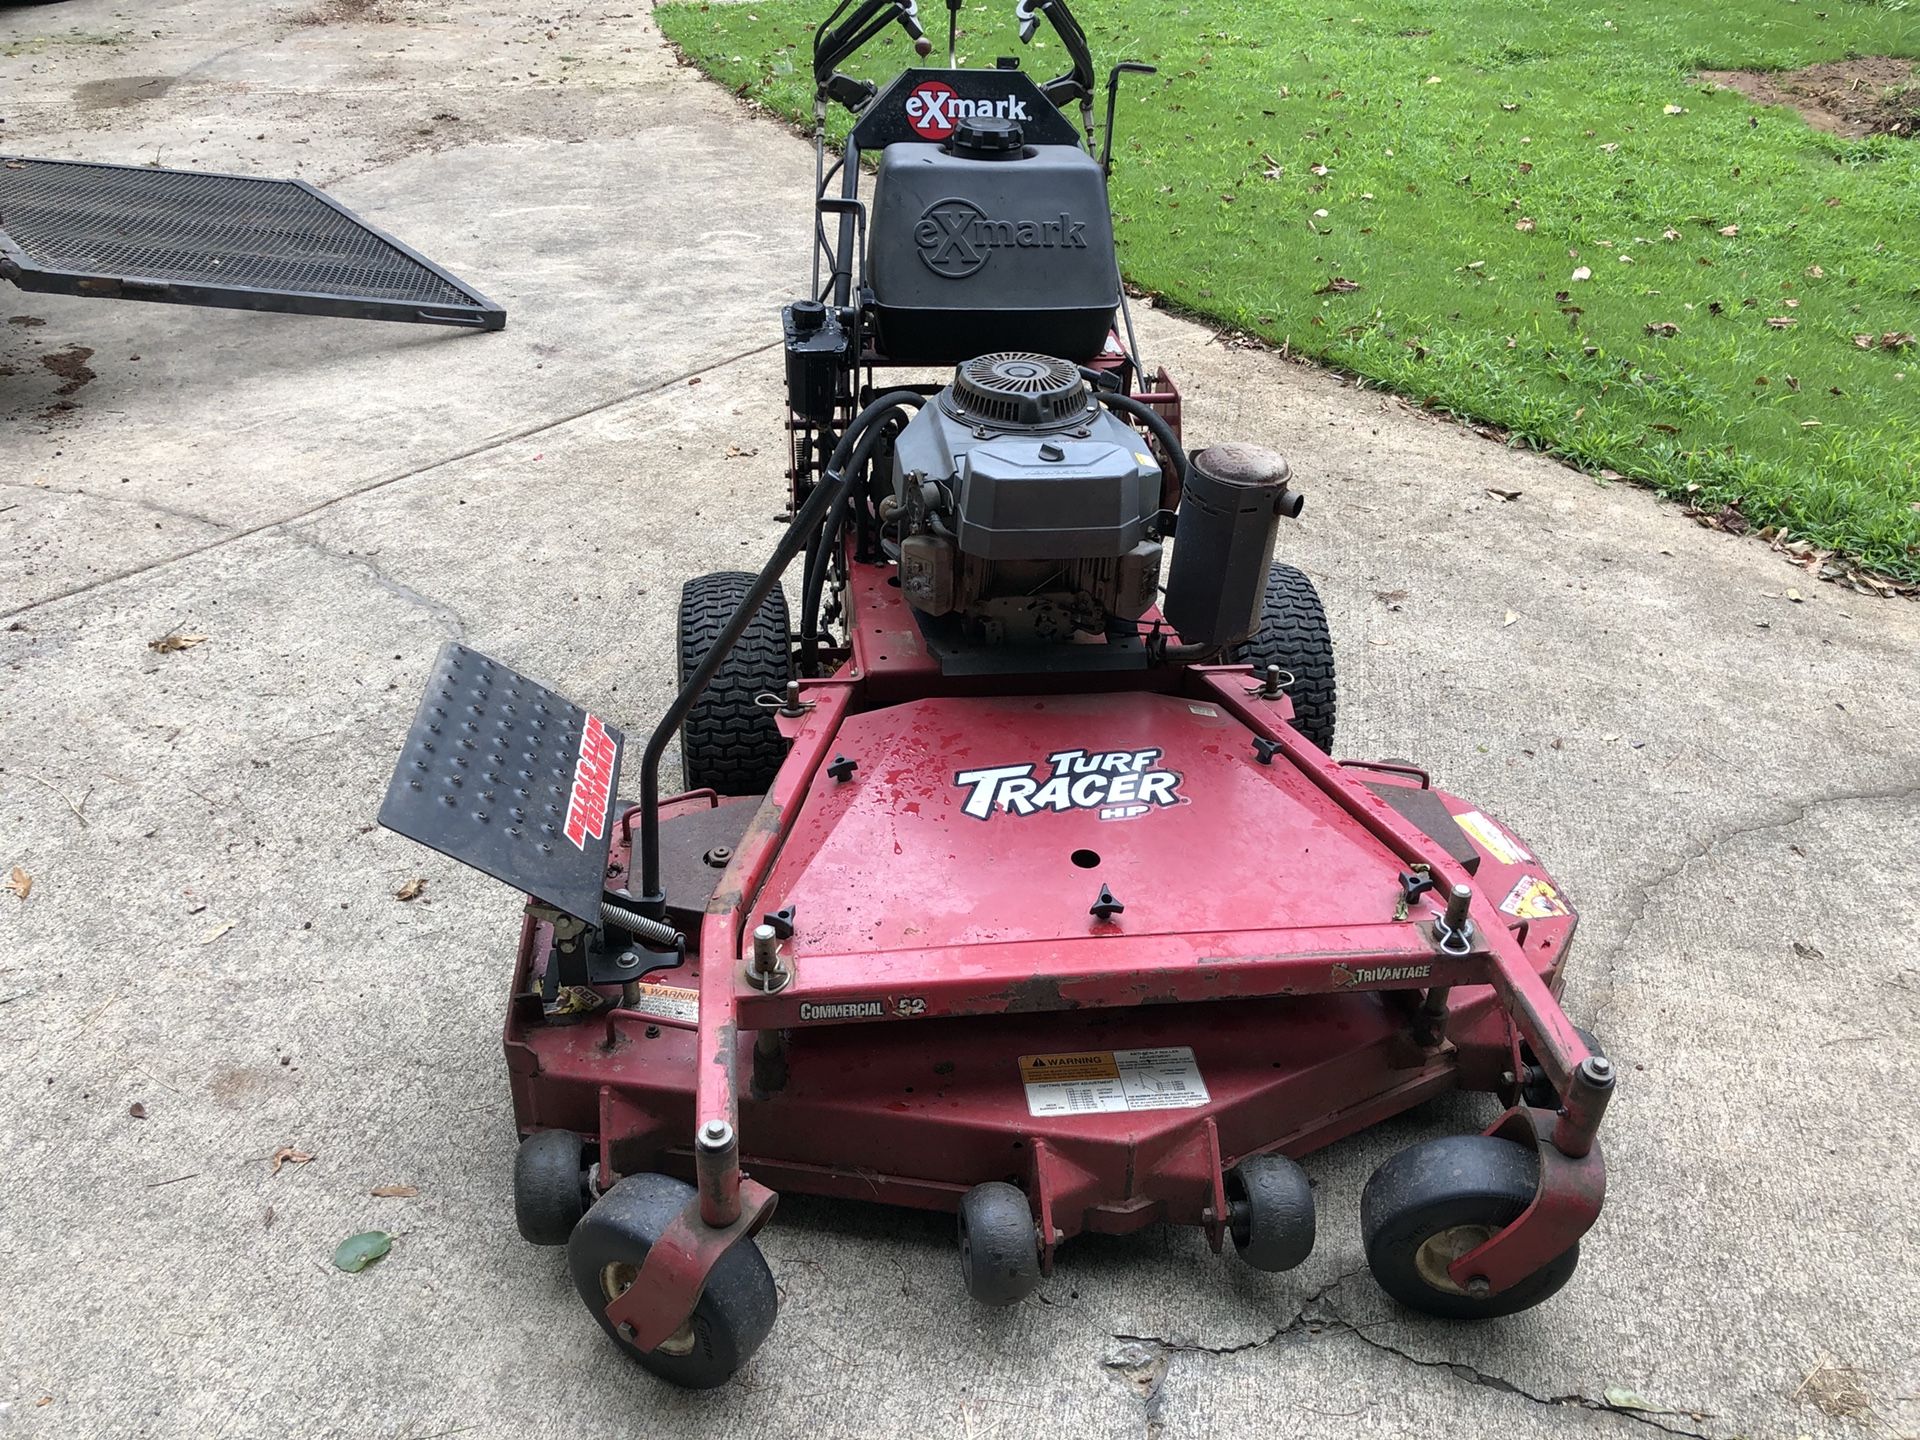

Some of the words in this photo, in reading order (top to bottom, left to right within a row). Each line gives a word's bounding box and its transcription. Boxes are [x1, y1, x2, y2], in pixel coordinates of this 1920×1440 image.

[905, 90, 1028, 129] eXmark
[913, 211, 1088, 266] eXmark
[581, 713, 604, 764] HUTE
[1049, 749, 1160, 776] TURF
[566, 760, 597, 847] SYSTEM
[587, 733, 616, 839] ADVANCED
[956, 766, 1182, 820] TRACER
[1099, 806, 1150, 821] HP
[651, 987, 699, 1001] WARNIN
[800, 1003, 883, 1020] COMMERCIAL
[898, 998, 926, 1015] 52
[1047, 1056, 1102, 1066] WARNING
